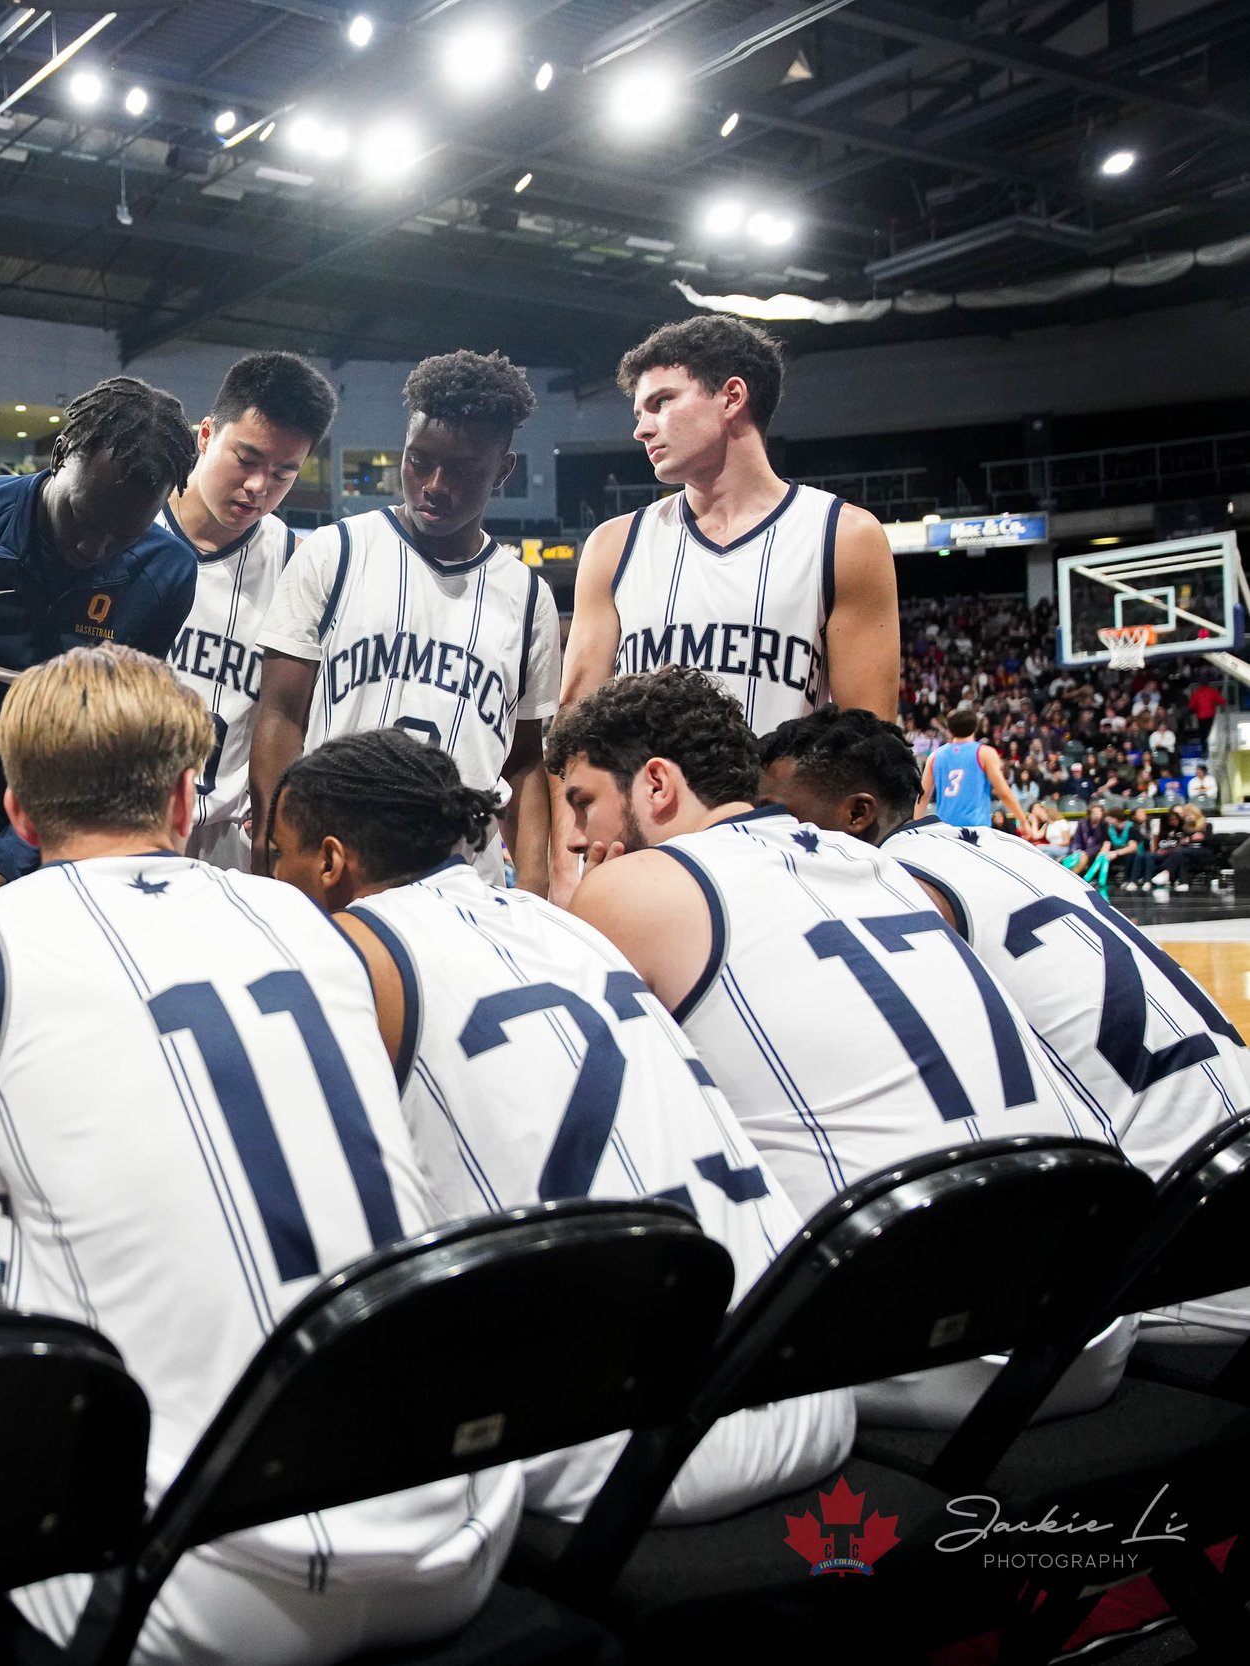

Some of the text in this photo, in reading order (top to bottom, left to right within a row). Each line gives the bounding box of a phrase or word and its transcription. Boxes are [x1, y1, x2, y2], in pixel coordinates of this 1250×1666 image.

[87, 593, 111, 623] Q
[75, 624, 115, 639] BASKETBALL
[944, 768, 964, 798] 3
[803, 910, 1039, 1123] 17
[147, 970, 406, 1283] 11
